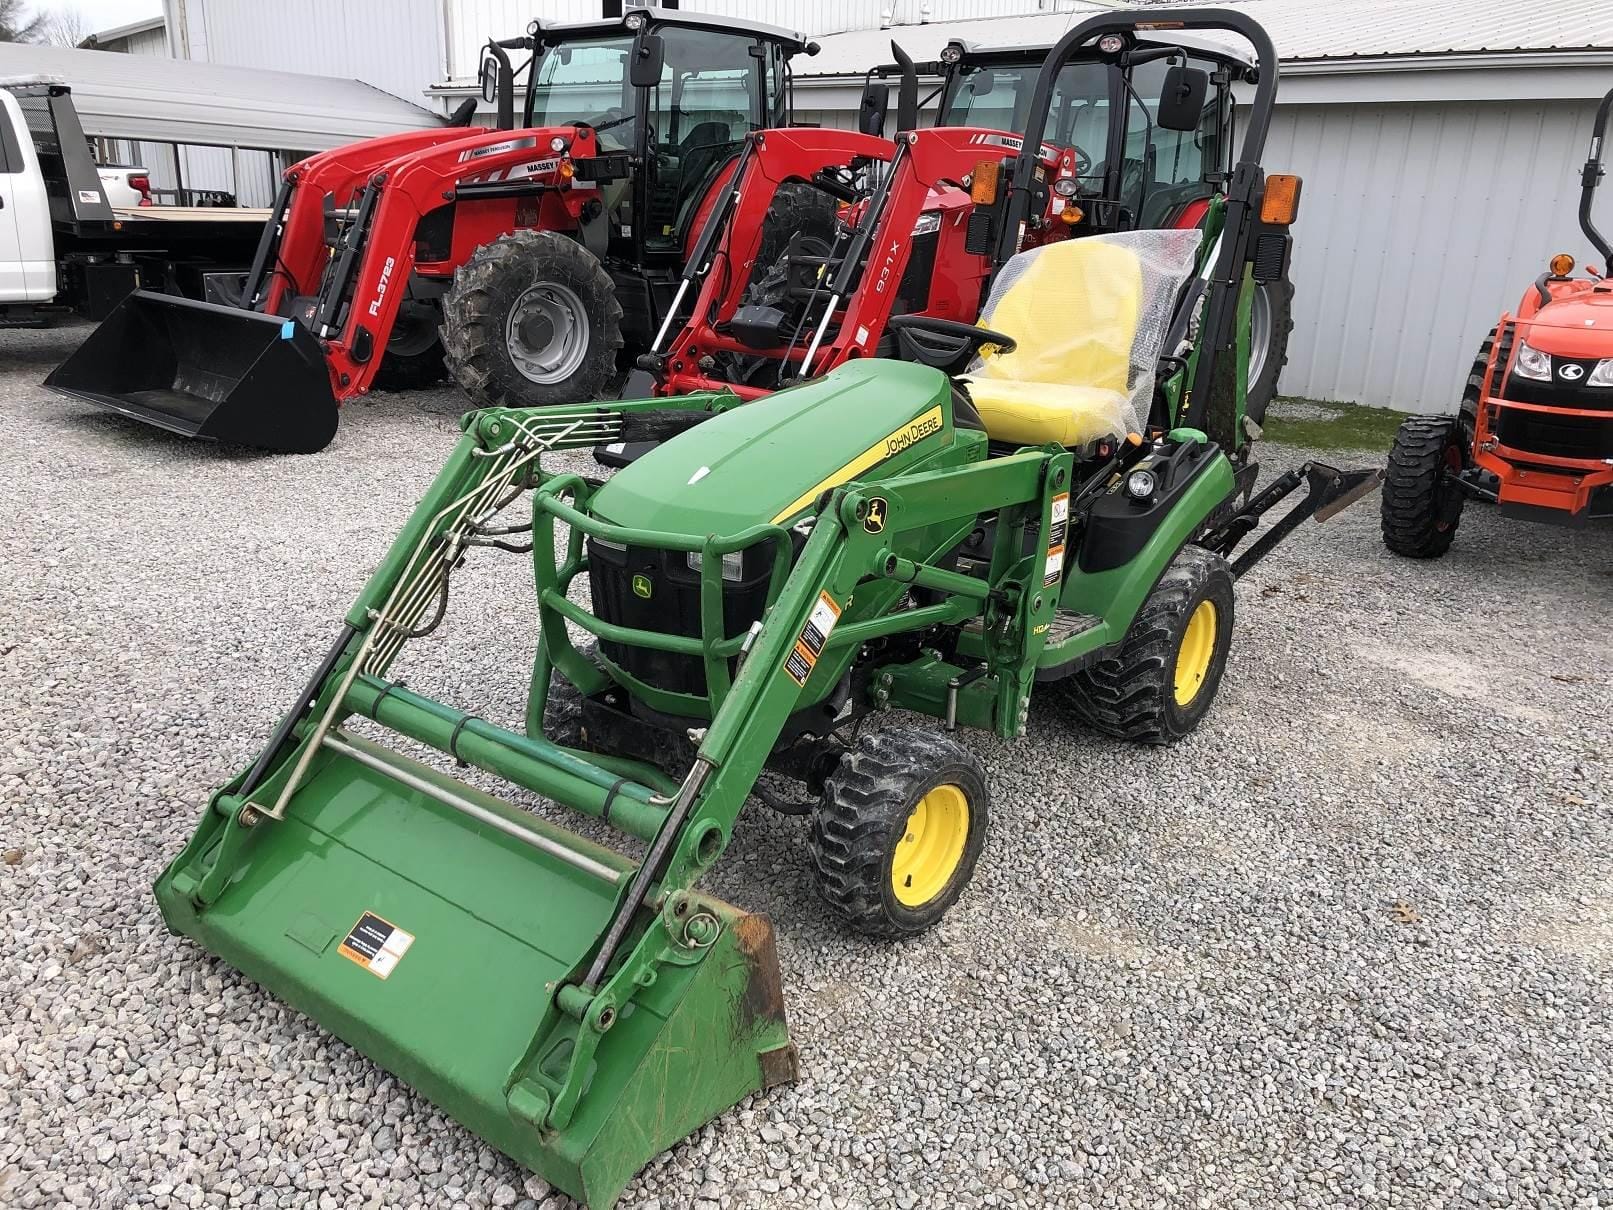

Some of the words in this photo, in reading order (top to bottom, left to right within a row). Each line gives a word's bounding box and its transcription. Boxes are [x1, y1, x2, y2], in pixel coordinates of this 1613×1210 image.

[526, 161, 554, 173] MASSEY
[884, 431, 911, 456] JOHN
[910, 416, 939, 440] DEERE
